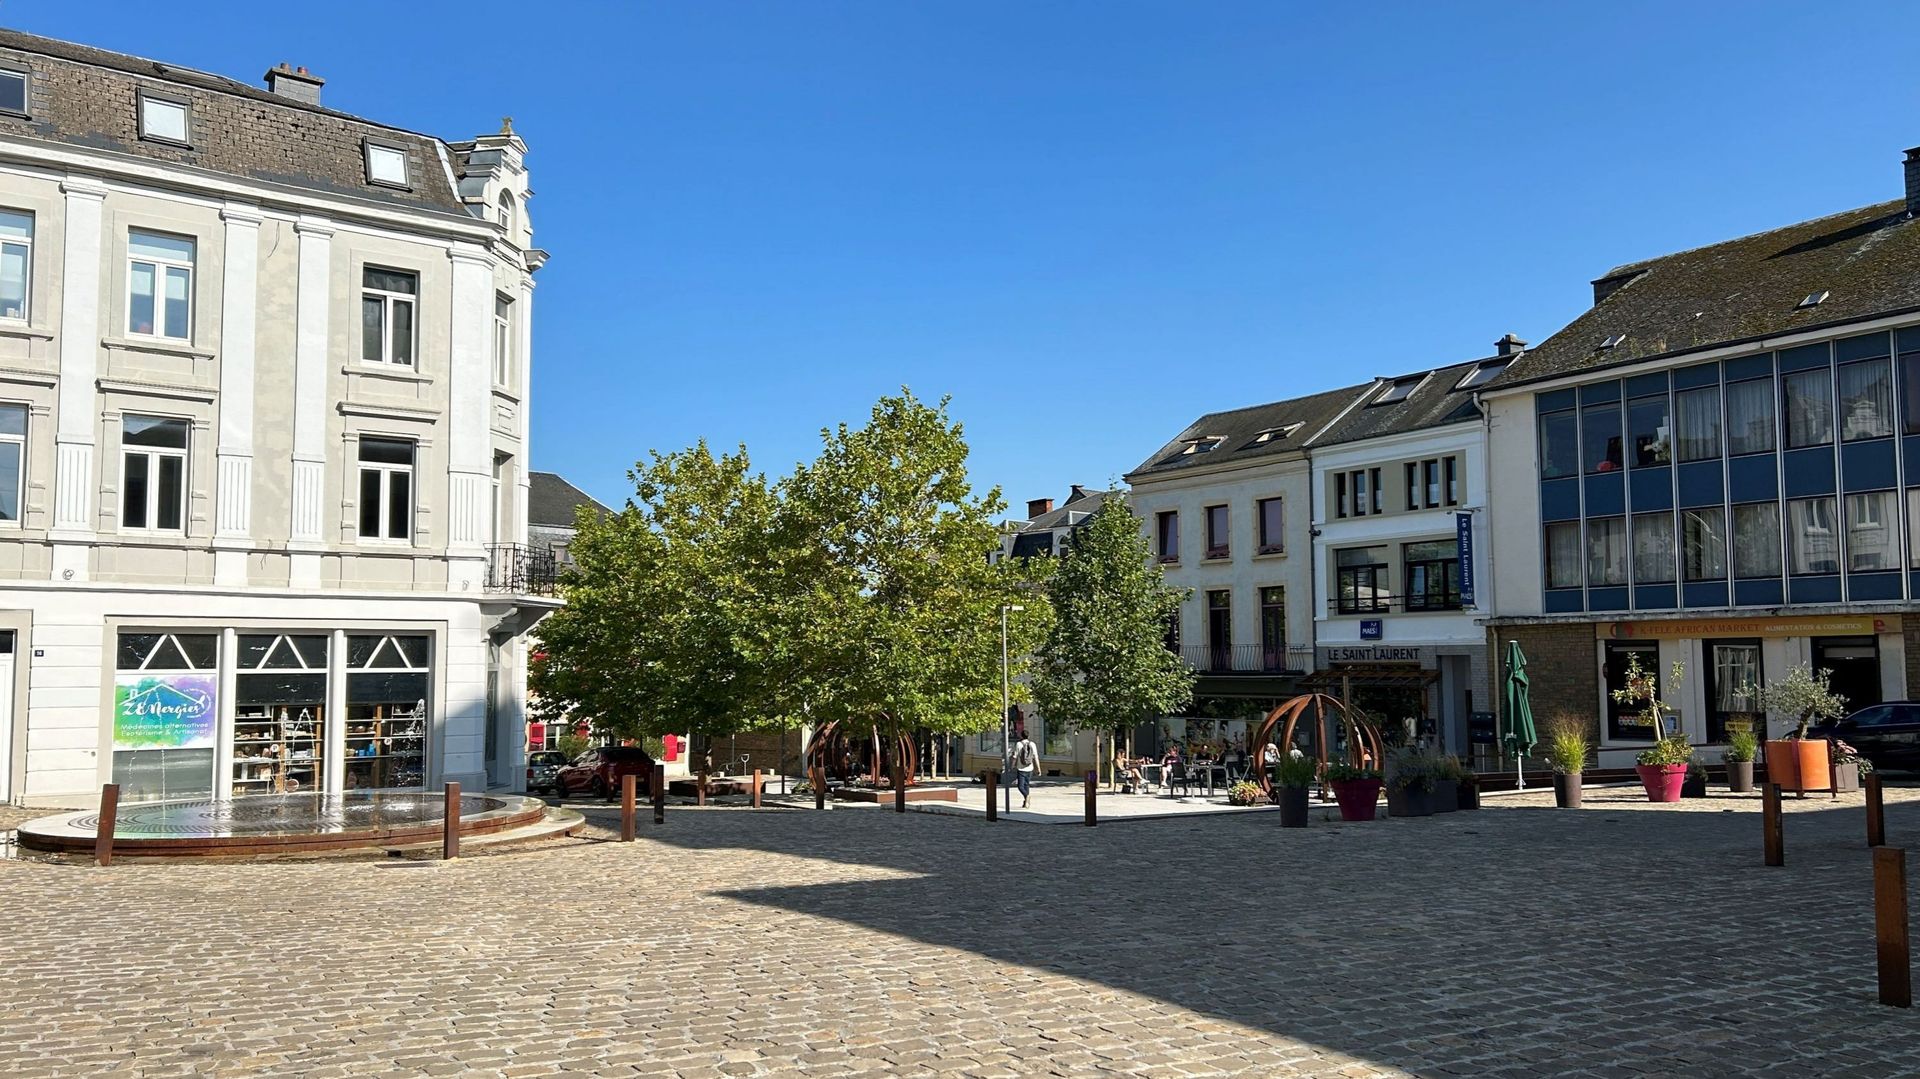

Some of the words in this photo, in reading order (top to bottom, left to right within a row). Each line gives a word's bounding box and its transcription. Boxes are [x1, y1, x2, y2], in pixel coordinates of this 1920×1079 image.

[1675, 625, 1715, 634] AFRICAN
[1717, 623, 1760, 633] MARKET
[1328, 649, 1339, 660] LE
[1342, 648, 1372, 660] SAINT
[1374, 648, 1420, 660] LAURENT
